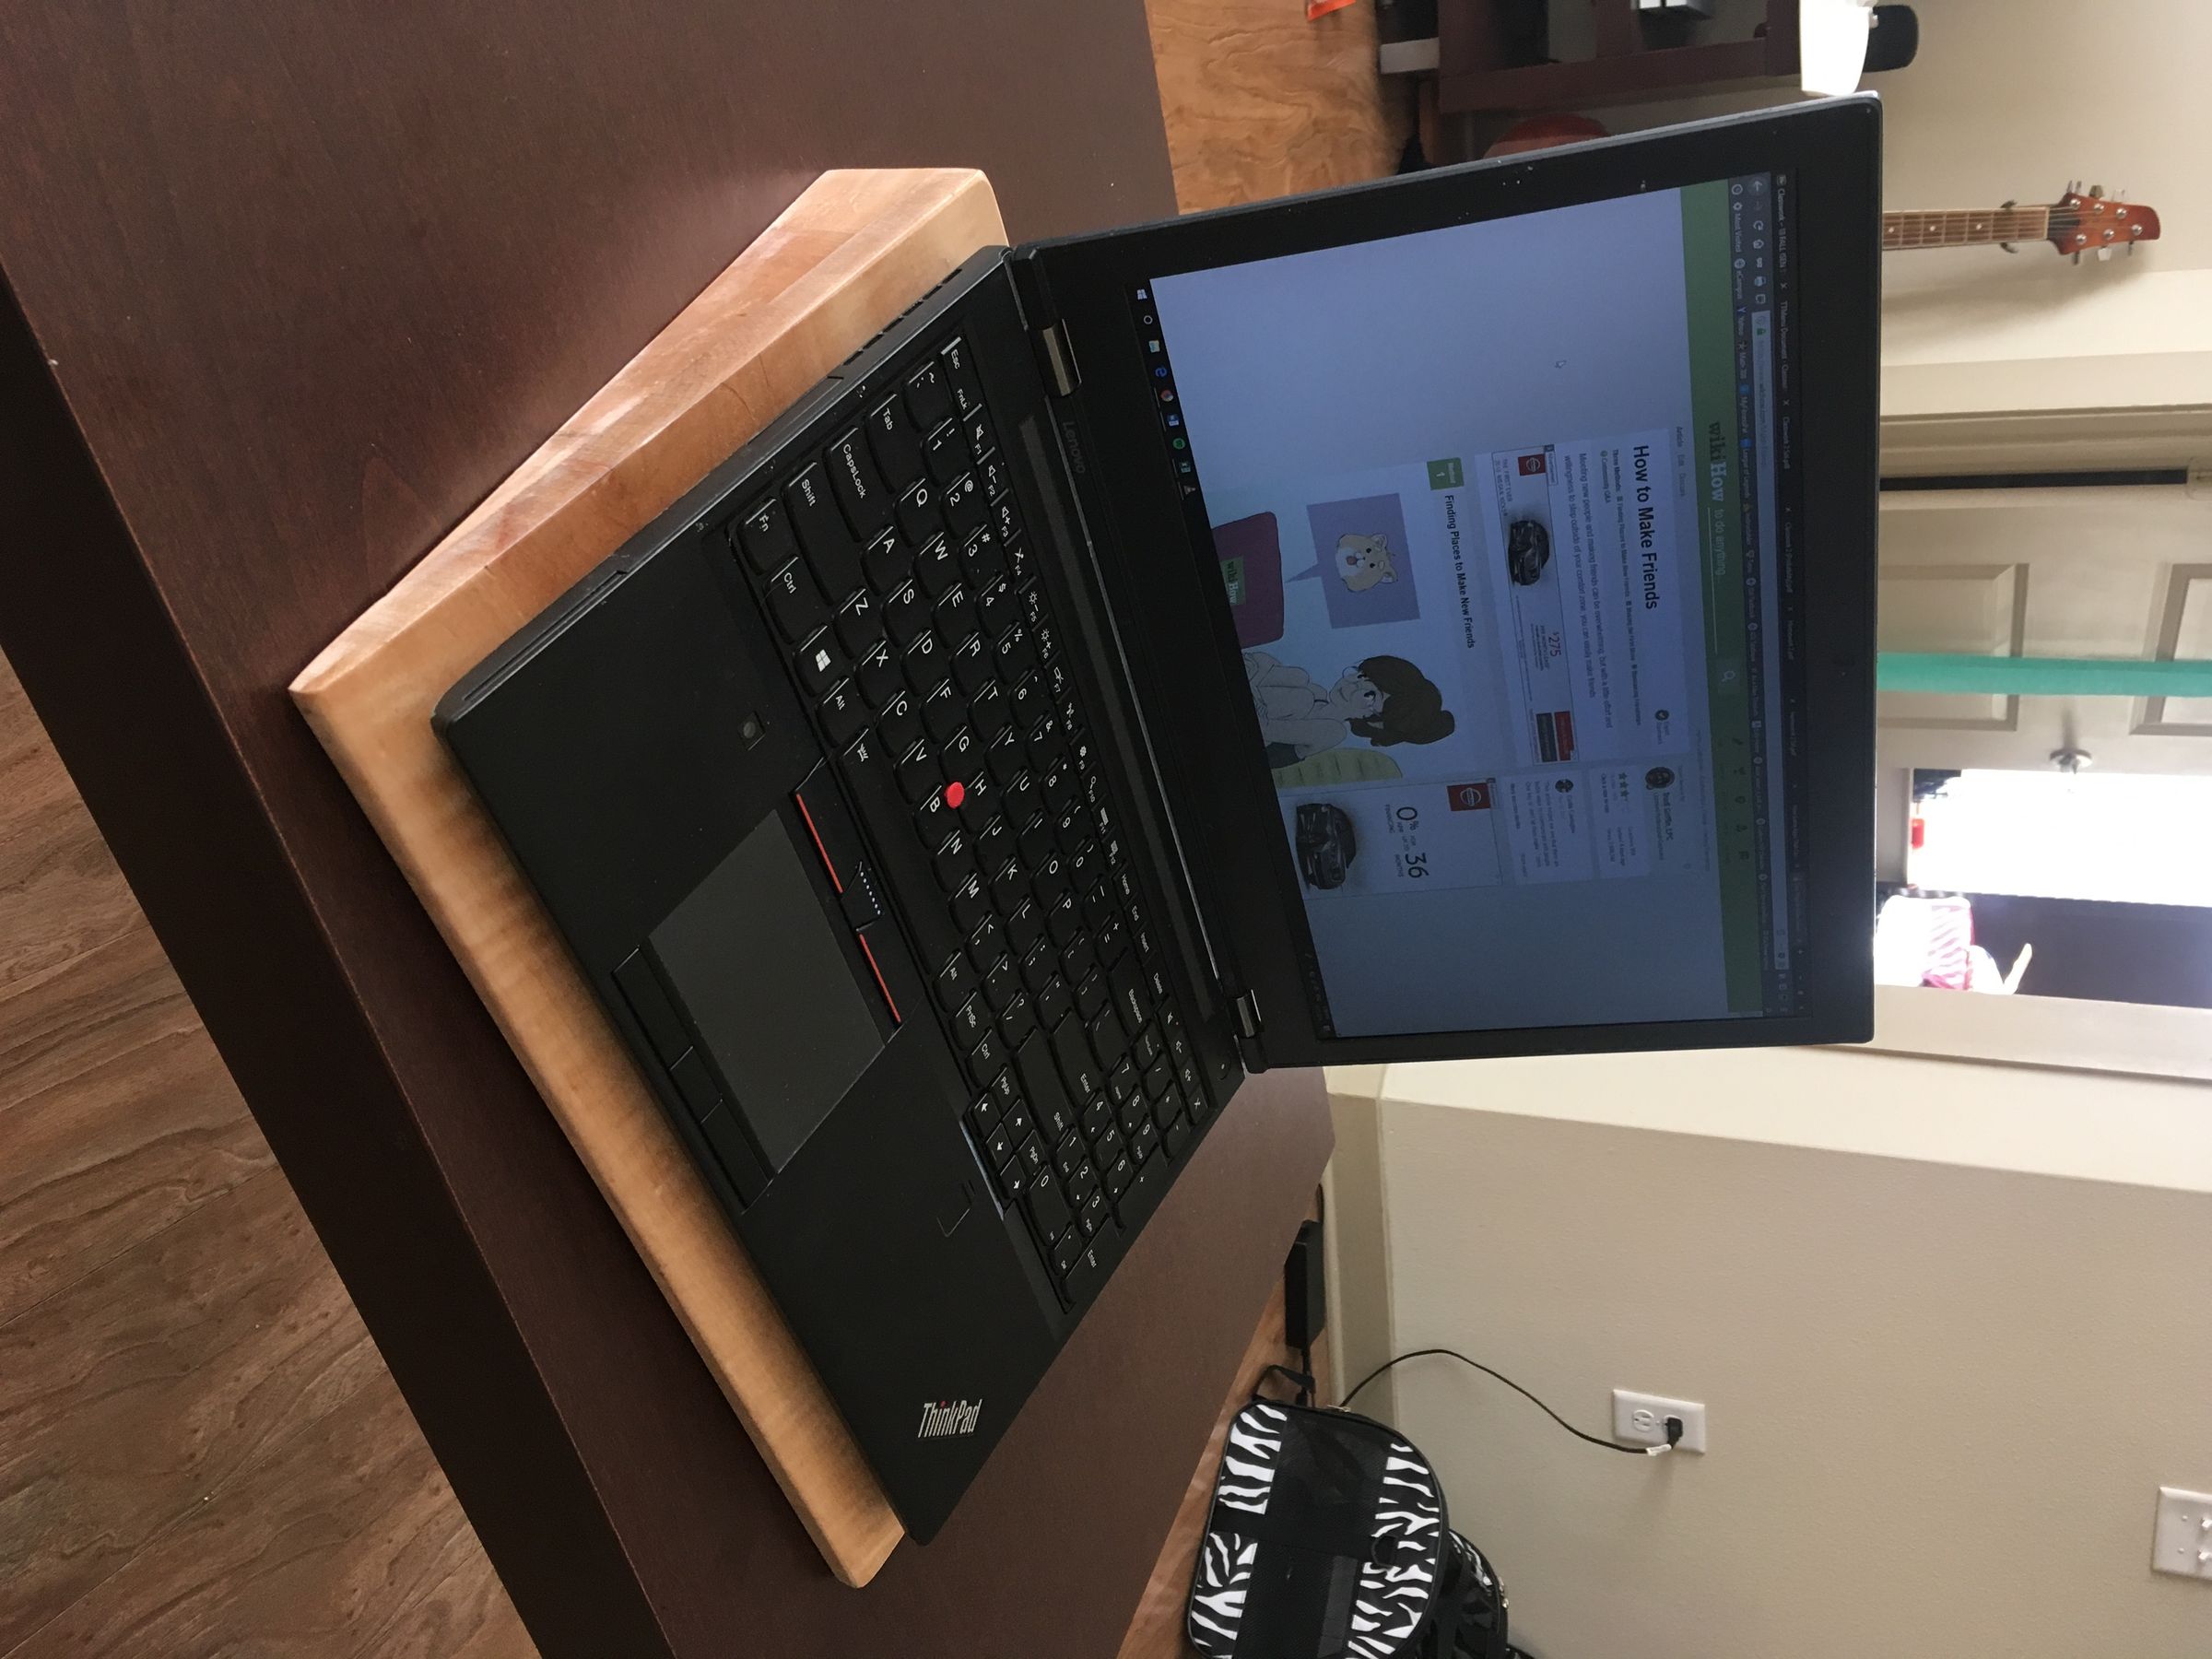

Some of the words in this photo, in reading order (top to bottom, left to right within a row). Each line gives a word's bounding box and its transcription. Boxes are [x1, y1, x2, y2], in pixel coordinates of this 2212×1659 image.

[950, 349, 961, 369] Esc
[956, 388, 969, 410] FnLk
[882, 407, 895, 430] Tab
[1676, 426, 1685, 448] Article
[932, 439, 943, 452] 1
[973, 443, 982, 456] F1
[1578, 453, 1589, 481] Meeting
[1633, 445, 1651, 483] How
[1708, 422, 1727, 501] wikiHow
[842, 443, 867, 500] CapsLock
[1563, 455, 1576, 494] willingness
[964, 480, 974, 493] @
[1677, 472, 1687, 497] Discuss
[800, 478, 817, 508] Shift
[915, 488, 928, 508] Q
[949, 493, 960, 507] 2
[1569, 494, 1578, 503] to
[1636, 487, 1652, 502] to
[1445, 495, 1456, 529] Finding
[1569, 503, 1580, 518] step
[1582, 500, 1593, 523] people
[1714, 509, 1724, 519] to
[759, 513, 770, 533] Fn
[1585, 524, 1594, 537] and
[1638, 507, 1655, 548] Make
[1714, 521, 1725, 534] do
[981, 532, 991, 543] #
[1571, 520, 1582, 544] outside
[882, 538, 895, 554] A
[934, 540, 947, 561] W
[968, 544, 979, 557] 3
[1450, 531, 1460, 559] Places
[1585, 538, 1597, 563] making
[1454, 561, 1464, 571] to
[1572, 553, 1584, 569] your
[783, 571, 797, 594] Ctrl
[1576, 570, 1587, 594] comfort
[1589, 564, 1600, 586] friends
[1641, 552, 1660, 610] Friends
[1456, 573, 1465, 595] Make
[902, 588, 915, 605] S
[951, 590, 963, 607] E
[985, 596, 994, 606] 4
[1591, 588, 1600, 600] can
[855, 596, 869, 616] Z
[1460, 597, 1470, 616] New
[1594, 601, 1603, 610] be
[1579, 615, 1589, 627] you
[1464, 618, 1475, 649] Friends
[921, 637, 933, 654] D
[969, 639, 981, 656] R
[1001, 641, 1010, 654] 5
[1547, 631, 1561, 657] $275
[1582, 640, 1593, 658] easily
[876, 648, 888, 667] X
[1599, 656, 1607, 667] but
[1584, 659, 1594, 677] make
[1600, 667, 1609, 680] with
[940, 686, 952, 699] F
[987, 686, 998, 700] T
[1018, 688, 1028, 700] 6
[1602, 687, 1611, 699] little
[835, 695, 846, 711] Alt
[896, 700, 907, 716] C
[1603, 700, 1612, 715] effort
[1604, 715, 1614, 728] and
[959, 735, 970, 752] G
[1004, 731, 1015, 746] Y
[1033, 731, 1043, 742] 7
[915, 747, 926, 761] V
[975, 778, 986, 796] H
[1019, 776, 1030, 791] U
[1048, 775, 1057, 787] 8
[929, 796, 941, 813] B
[1062, 817, 1071, 829] 9
[992, 827, 1002, 836] J
[950, 838, 963, 854] N
[1007, 865, 1018, 880] K
[1405, 852, 1430, 878] 36
[968, 880, 980, 899] M
[1021, 903, 1030, 919] L
[1061, 897, 1072, 910] P
[948, 967, 959, 980] Alt
[1127, 988, 1143, 1024] Backspace
[981, 1043, 991, 1059] Ctrl
[1121, 1063, 1130, 1074] 7
[1080, 1073, 1091, 1094] Enter
[1095, 1100, 1104, 1112] 4
[1132, 1095, 1140, 1107] 8
[1053, 1112, 1065, 1132] Shift
[1142, 1124, 1150, 1135] 9
[1069, 1136, 1077, 1147] 1
[1107, 1131, 1115, 1143] 5
[1079, 1166, 1088, 1179] 2
[1117, 1159, 1126, 1171] 6
[1041, 1175, 1049, 1188] 0
[1091, 1195, 1100, 1208] 3
[1087, 1250, 1097, 1268] Enter
[917, 1398, 984, 1438] ThinkPad
